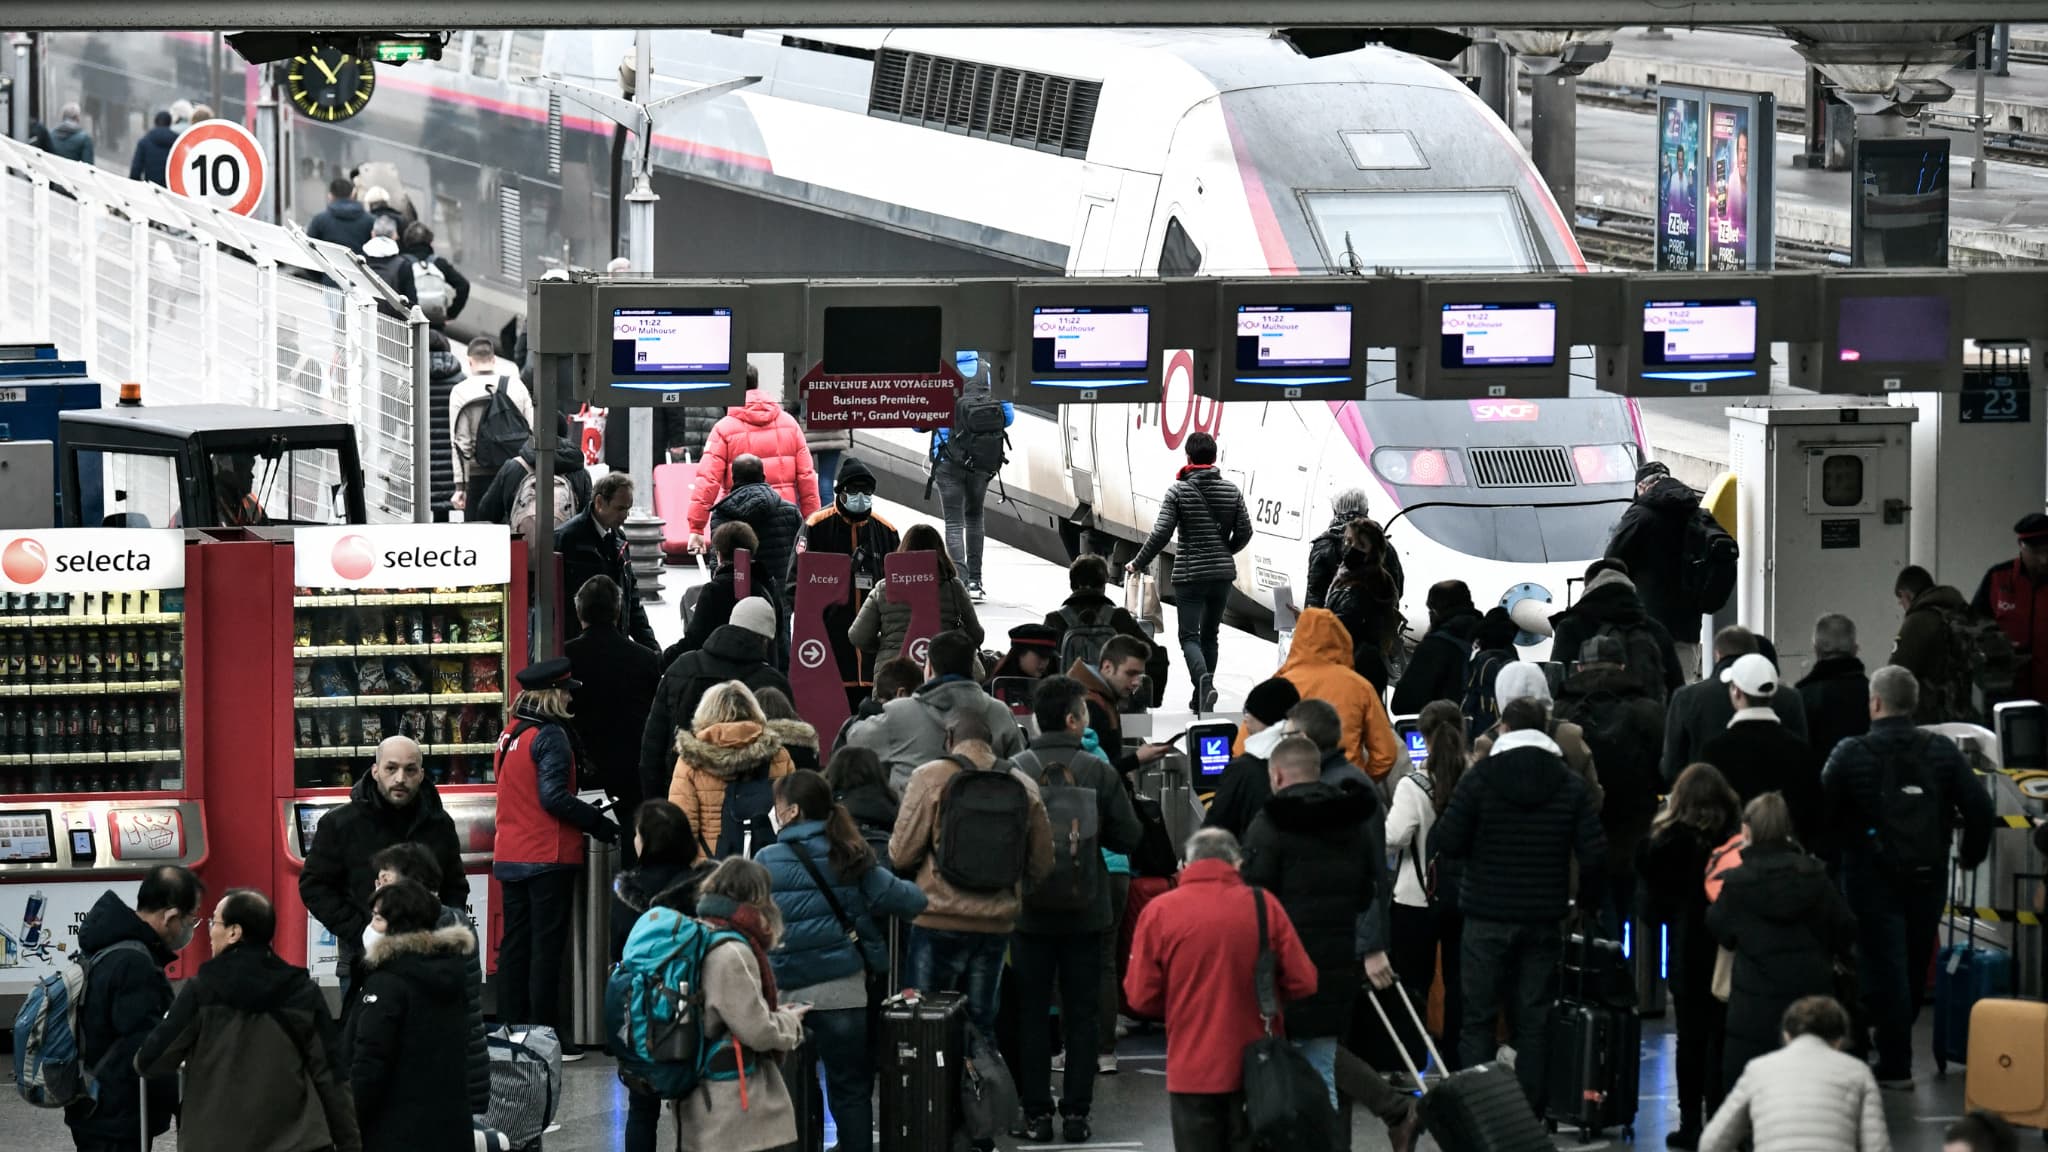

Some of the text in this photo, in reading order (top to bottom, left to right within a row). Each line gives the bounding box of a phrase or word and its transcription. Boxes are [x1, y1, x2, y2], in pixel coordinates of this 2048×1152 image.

[191, 154, 240, 196] 10
[1669, 215, 1690, 236] ZEbet
[639, 319, 662, 327] 11:22
[638, 327, 677, 335] Mulhouse
[808, 379, 954, 390] BIENVENUE AUX VOYAGEURS
[832, 395, 930, 406] Business Première,
[1984, 389, 2017, 414] 23
[811, 410, 848, 421] Liberté
[868, 410, 900, 420] Grand
[902, 410, 950, 421] Voyageur
[1475, 404, 1536, 419] SNCF
[1256, 498, 1282, 525] 258
[55, 550, 151, 573] selecta
[384, 546, 477, 568] selecta
[891, 573, 935, 584] Express
[74, 911, 89, 923] TO
